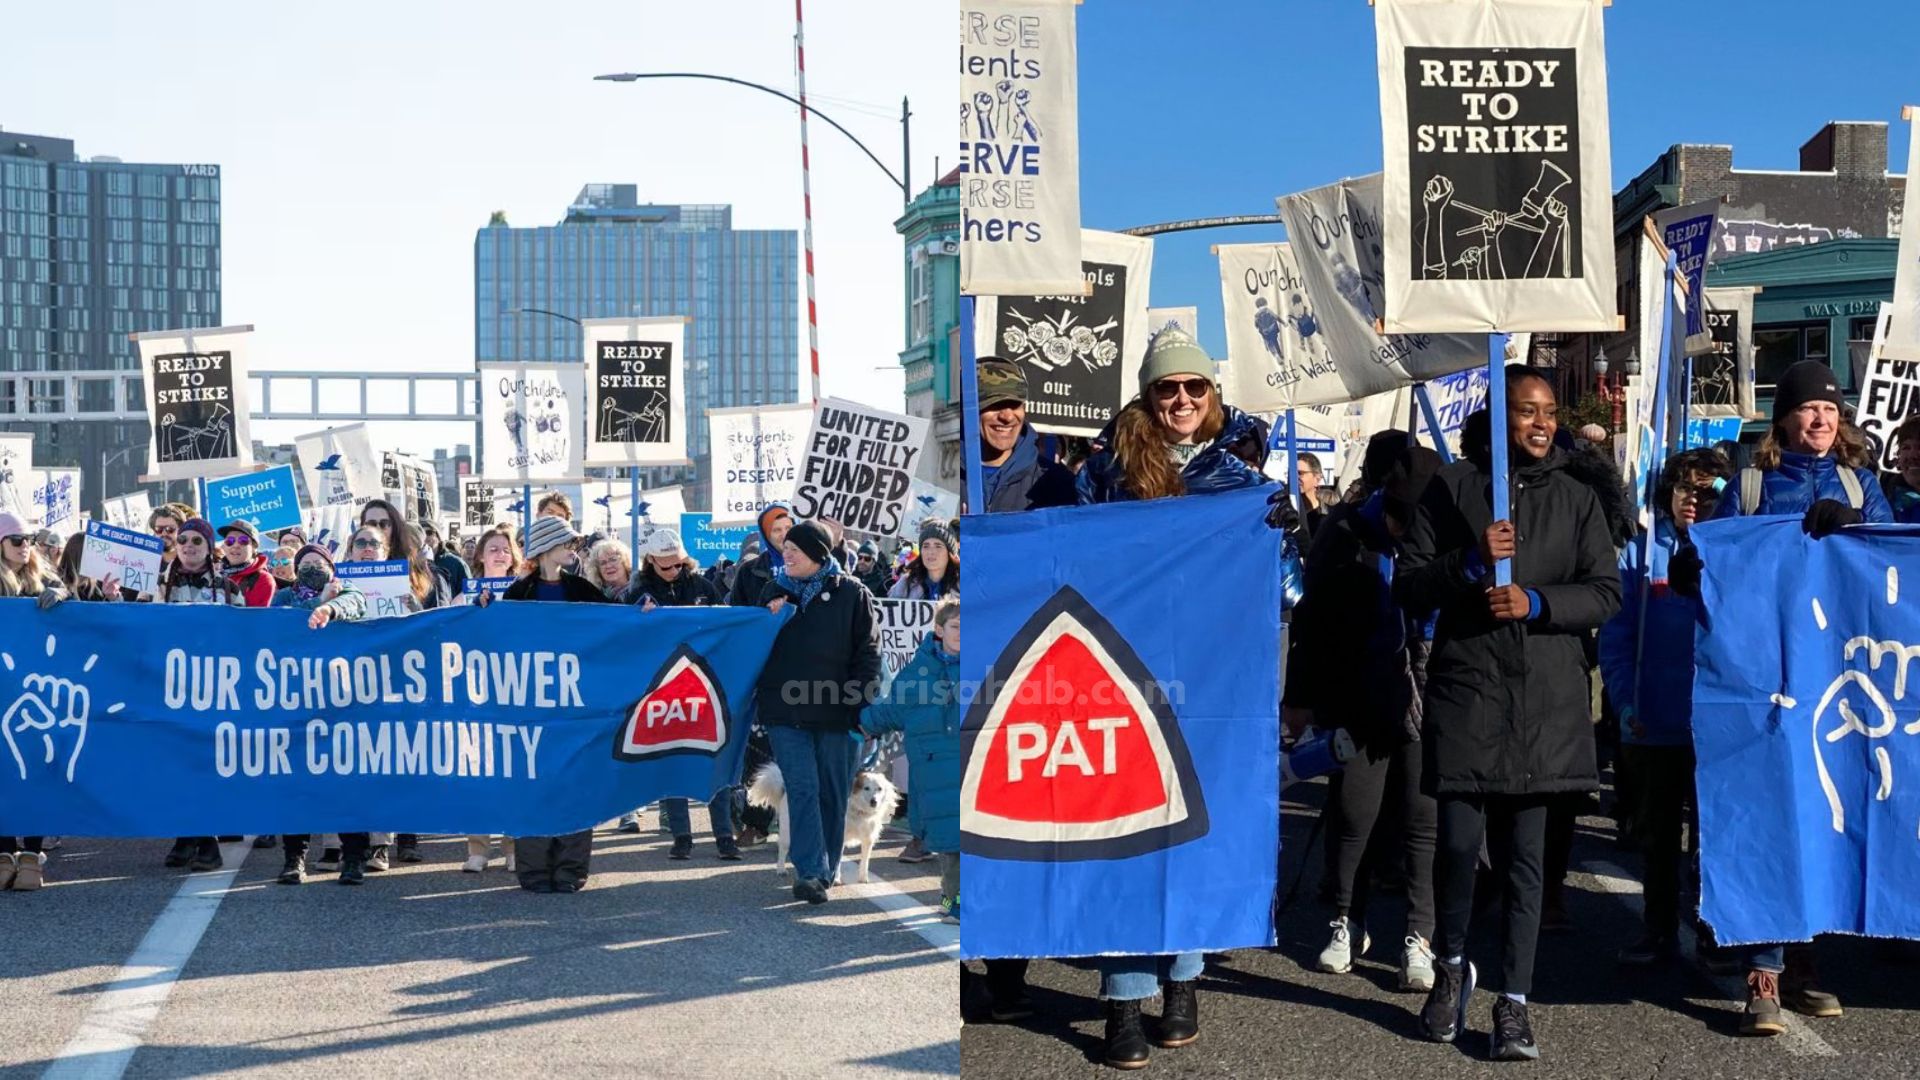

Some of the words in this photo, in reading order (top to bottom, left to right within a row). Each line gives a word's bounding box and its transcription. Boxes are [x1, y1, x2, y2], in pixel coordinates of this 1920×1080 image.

[960, 11, 1040, 48] RSE
[1419, 59, 1560, 87] READY
[1462, 92, 1519, 120] TO
[1417, 124, 1568, 153] STRIKE
[182, 164, 217, 177] YARD
[960, 178, 1035, 209] RSE
[1311, 210, 1350, 250] Our
[1666, 221, 1708, 246] READY
[1679, 241, 1692, 258] TO
[1245, 268, 1278, 295] Our
[1809, 303, 1841, 316] WAX
[158, 355, 223, 374] READY
[602, 346, 665, 360] READY
[179, 372, 205, 386] TO
[620, 360, 646, 374] TO
[500, 377, 525, 397] Our
[524, 379, 567, 400] children
[600, 374, 667, 388] STRIKE
[1043, 380, 1073, 396] our
[158, 386, 229, 404] STRIKE
[820, 407, 910, 443] UNITED
[812, 431, 852, 459] FOR
[856, 439, 918, 470] FULLY
[727, 467, 795, 484] DESERVE
[803, 456, 910, 502] FUNDED
[221, 477, 276, 502] Support
[221, 496, 284, 520] Teachers!
[793, 485, 902, 535] SCHOOLS
[101, 528, 111, 537] WE
[124, 567, 154, 591] PAT
[337, 567, 348, 575] WE
[349, 566, 373, 574] EDUCATE
[374, 565, 386, 574] OUR
[386, 564, 403, 573] STATE
[481, 581, 492, 589] WE
[376, 595, 404, 616] PAT
[165, 648, 241, 711] OUR
[254, 647, 427, 711] SCHOOLS
[441, 642, 585, 708] POWER
[646, 696, 708, 728] PAT
[215, 720, 292, 778] OUR
[306, 718, 544, 780] COMMUNITY
[1005, 716, 1130, 784] PAT
